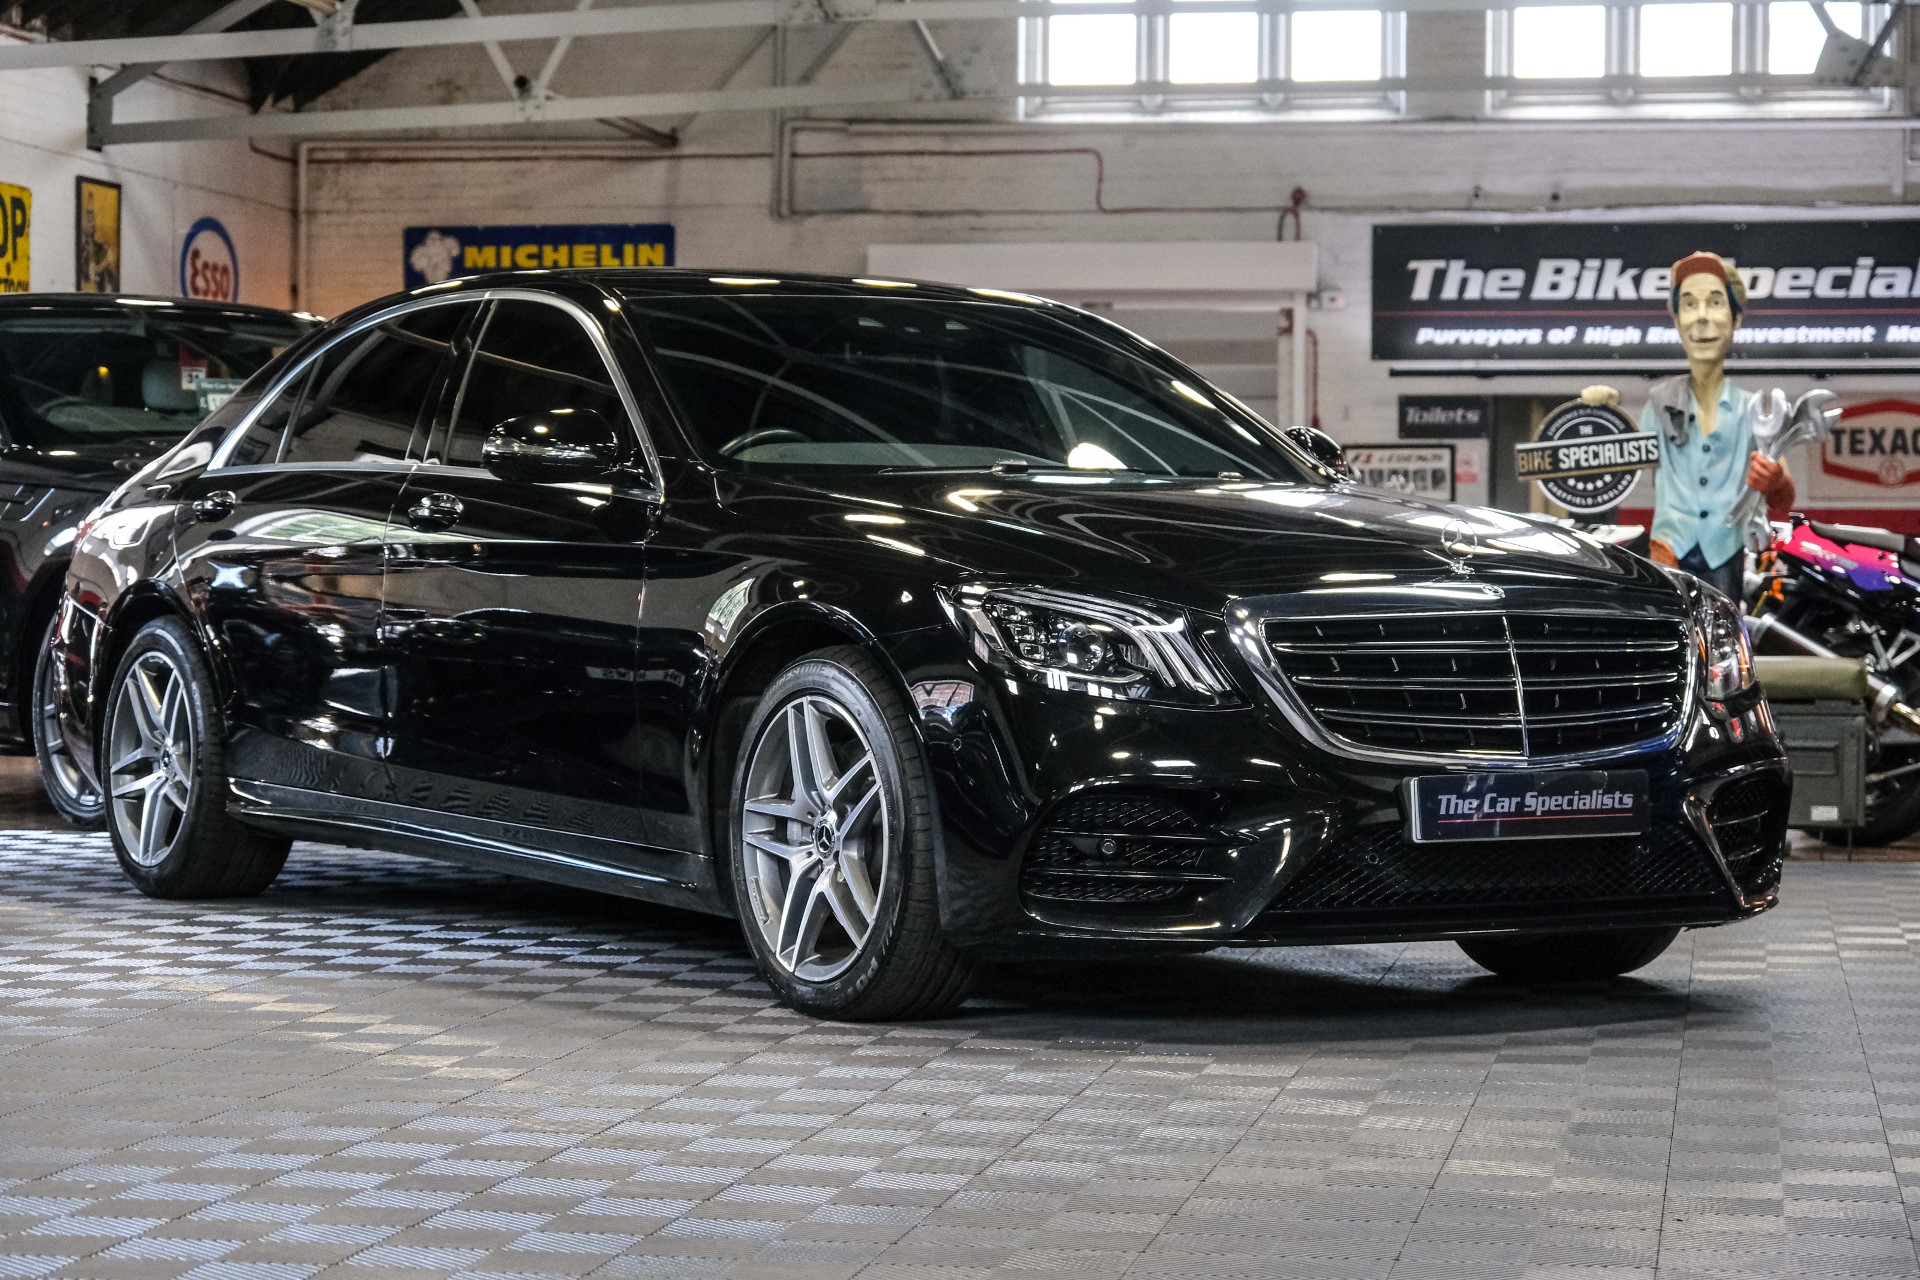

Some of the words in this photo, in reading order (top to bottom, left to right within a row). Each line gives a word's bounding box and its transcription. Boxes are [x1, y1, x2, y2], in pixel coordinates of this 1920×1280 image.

[463, 243, 666, 269] MICHELIN
[1406, 258, 1526, 301] The
[1530, 258, 1673, 301] Bike
[1415, 327, 1544, 347] Purveyors
[1546, 326, 1578, 345] of
[1583, 326, 1643, 347] High
[1405, 406, 1483, 425] Toilets
[1578, 425, 1594, 436] THE
[1518, 450, 1553, 473] BIKE
[1557, 438, 1660, 470] SPECIALISTS
[1437, 794, 1478, 816] The
[1483, 792, 1521, 814] Car
[1523, 789, 1634, 817] Specialists
